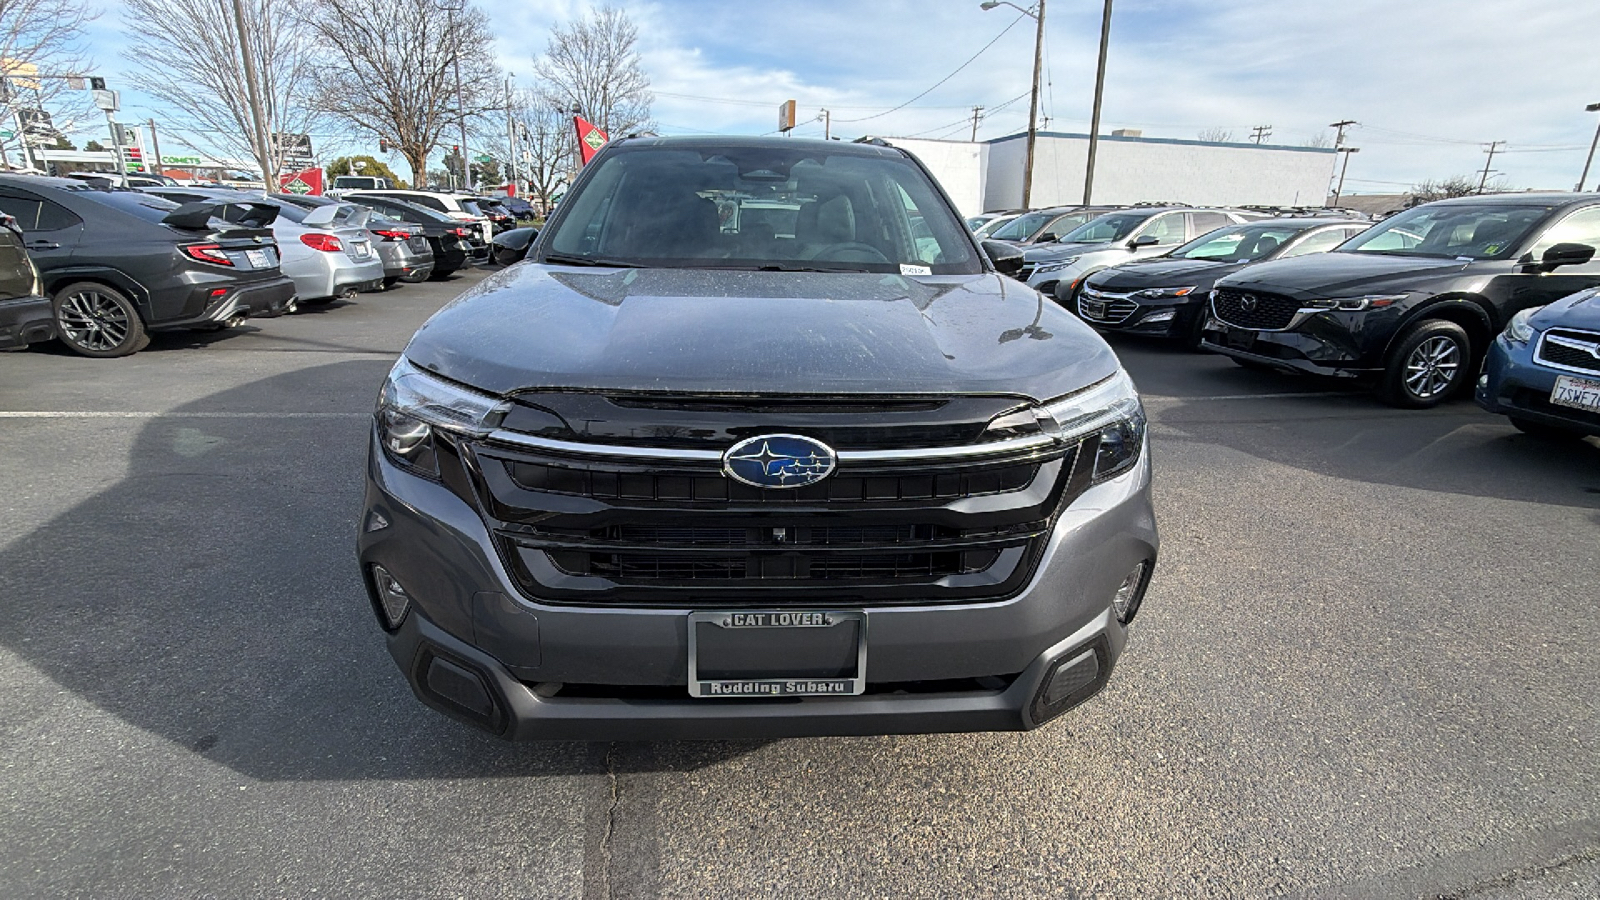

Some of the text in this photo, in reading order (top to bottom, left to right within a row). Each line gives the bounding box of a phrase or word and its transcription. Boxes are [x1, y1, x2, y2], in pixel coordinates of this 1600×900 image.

[734, 613, 824, 626] CAT LOVER
[711, 681, 844, 694] Redding Subaru
